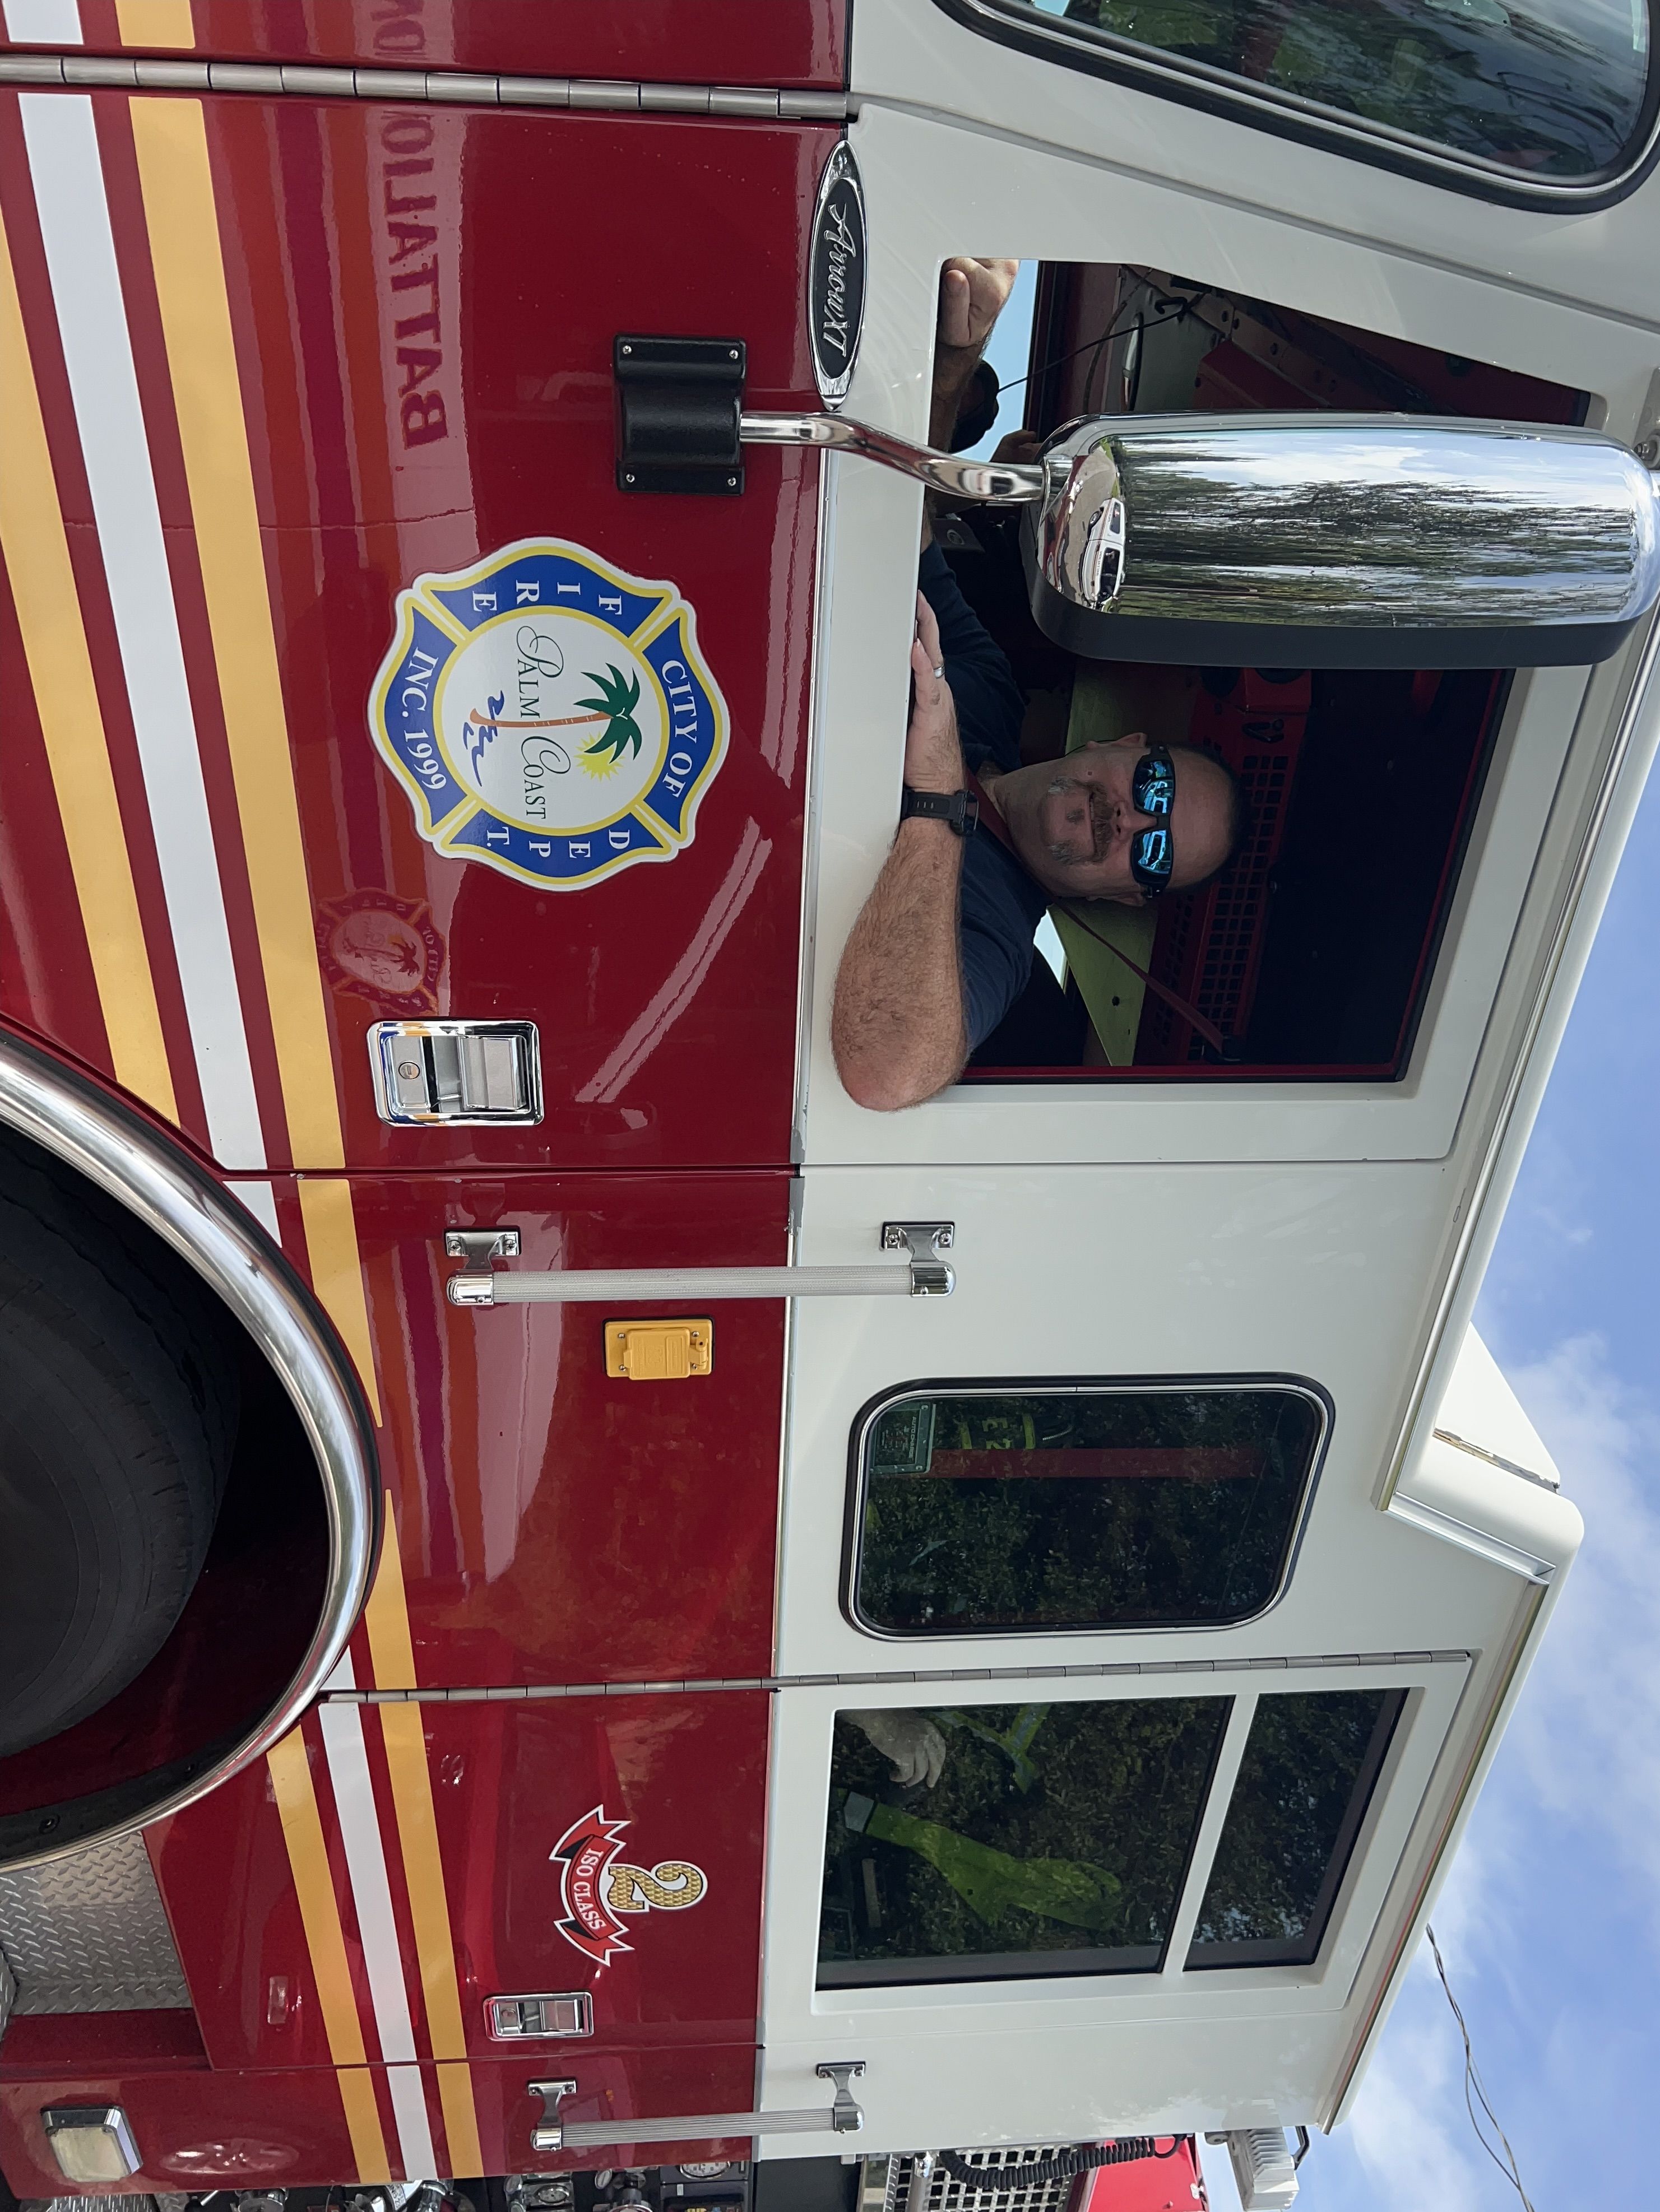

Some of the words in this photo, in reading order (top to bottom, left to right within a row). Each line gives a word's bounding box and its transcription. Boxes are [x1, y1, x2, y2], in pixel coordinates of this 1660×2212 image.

[471, 579, 622, 615] FIRE
[401, 647, 440, 718] INC.
[515, 625, 565, 719] PALM
[661, 660, 698, 743] CITY
[405, 728, 448, 791] 1999
[521, 735, 571, 820] COAST
[662, 751, 693, 797] OF
[485, 826, 630, 858] DEPT.
[576, 1848, 604, 1876] ISO
[572, 1881, 605, 1930] CLASS
[608, 1863, 704, 1911] 2
